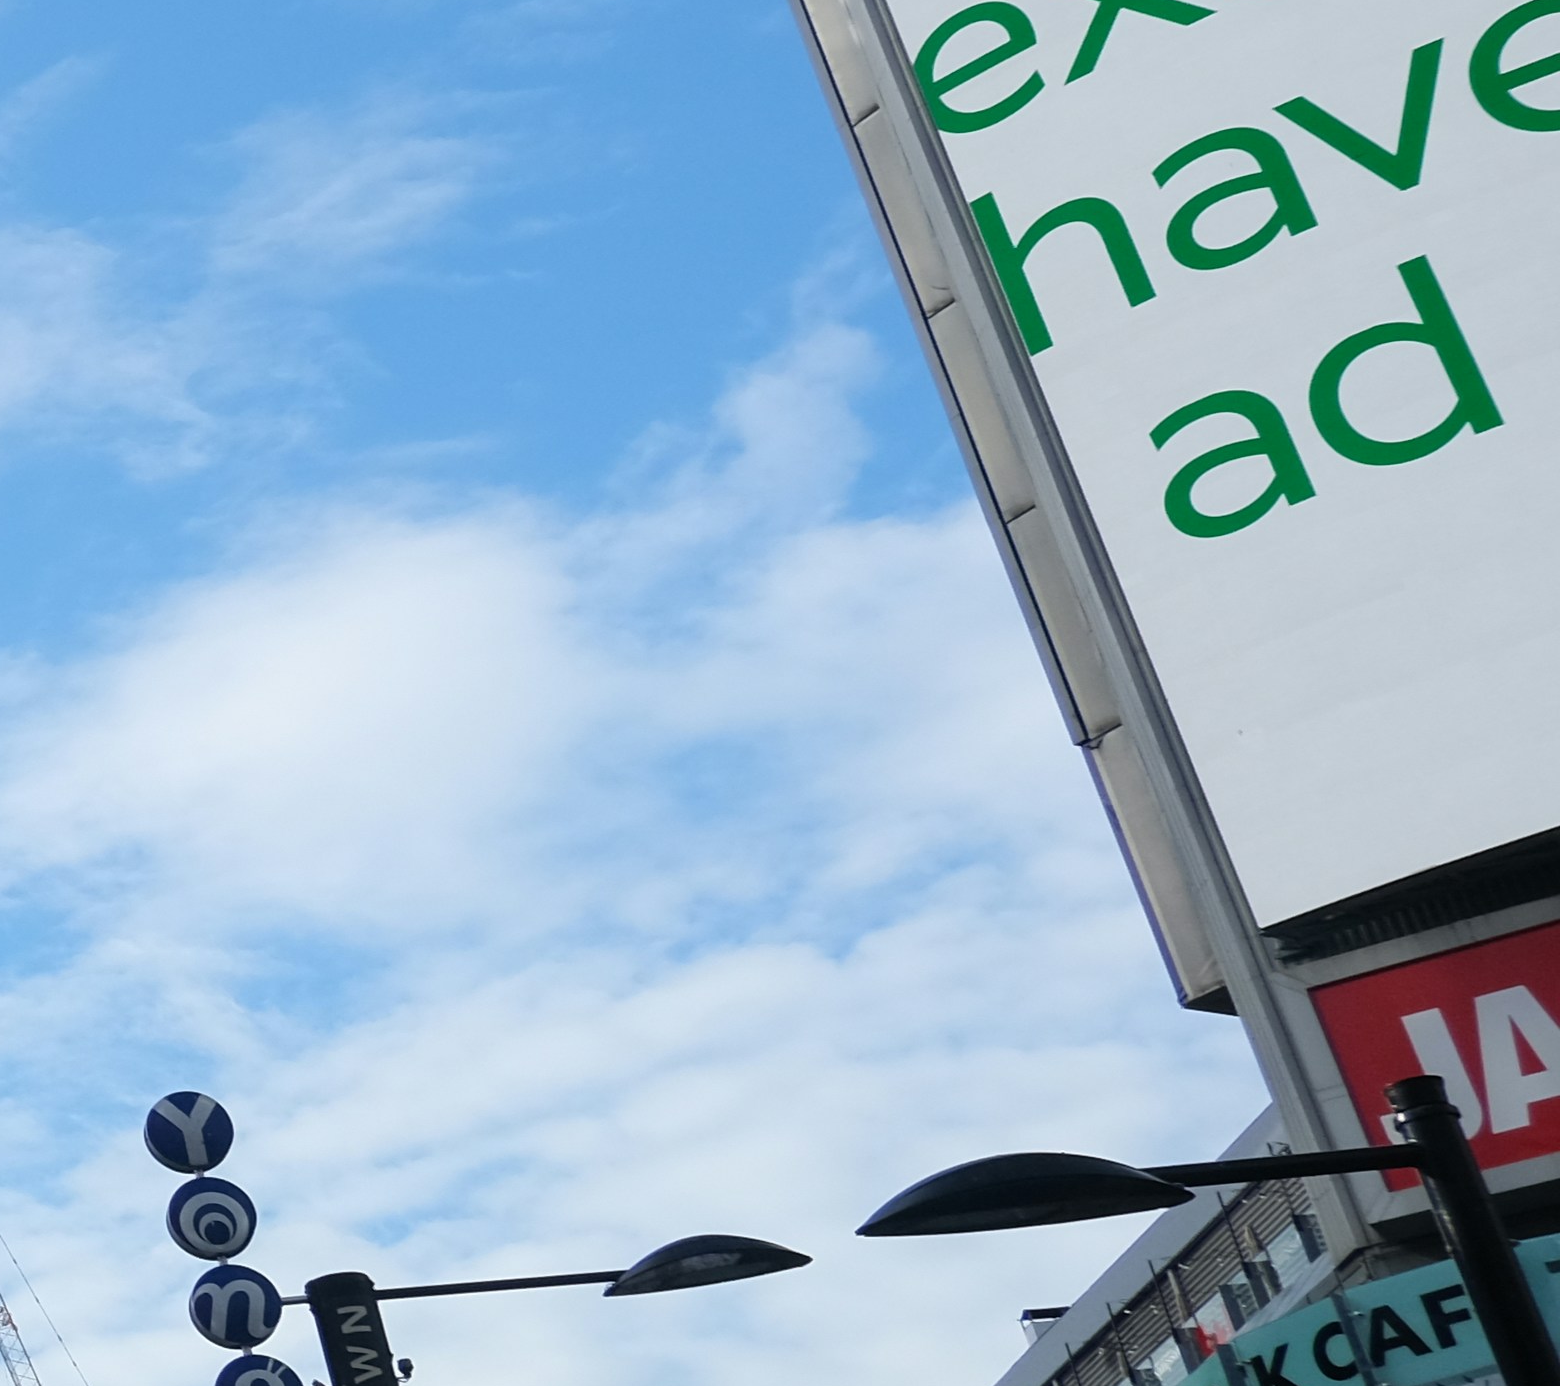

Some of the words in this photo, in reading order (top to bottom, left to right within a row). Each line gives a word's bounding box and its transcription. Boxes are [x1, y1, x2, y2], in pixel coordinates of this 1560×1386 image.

[1149, 254, 1504, 539] ad
[1378, 983, 1560, 1145] JA
[1312, 1283, 1474, 1381] CAF
